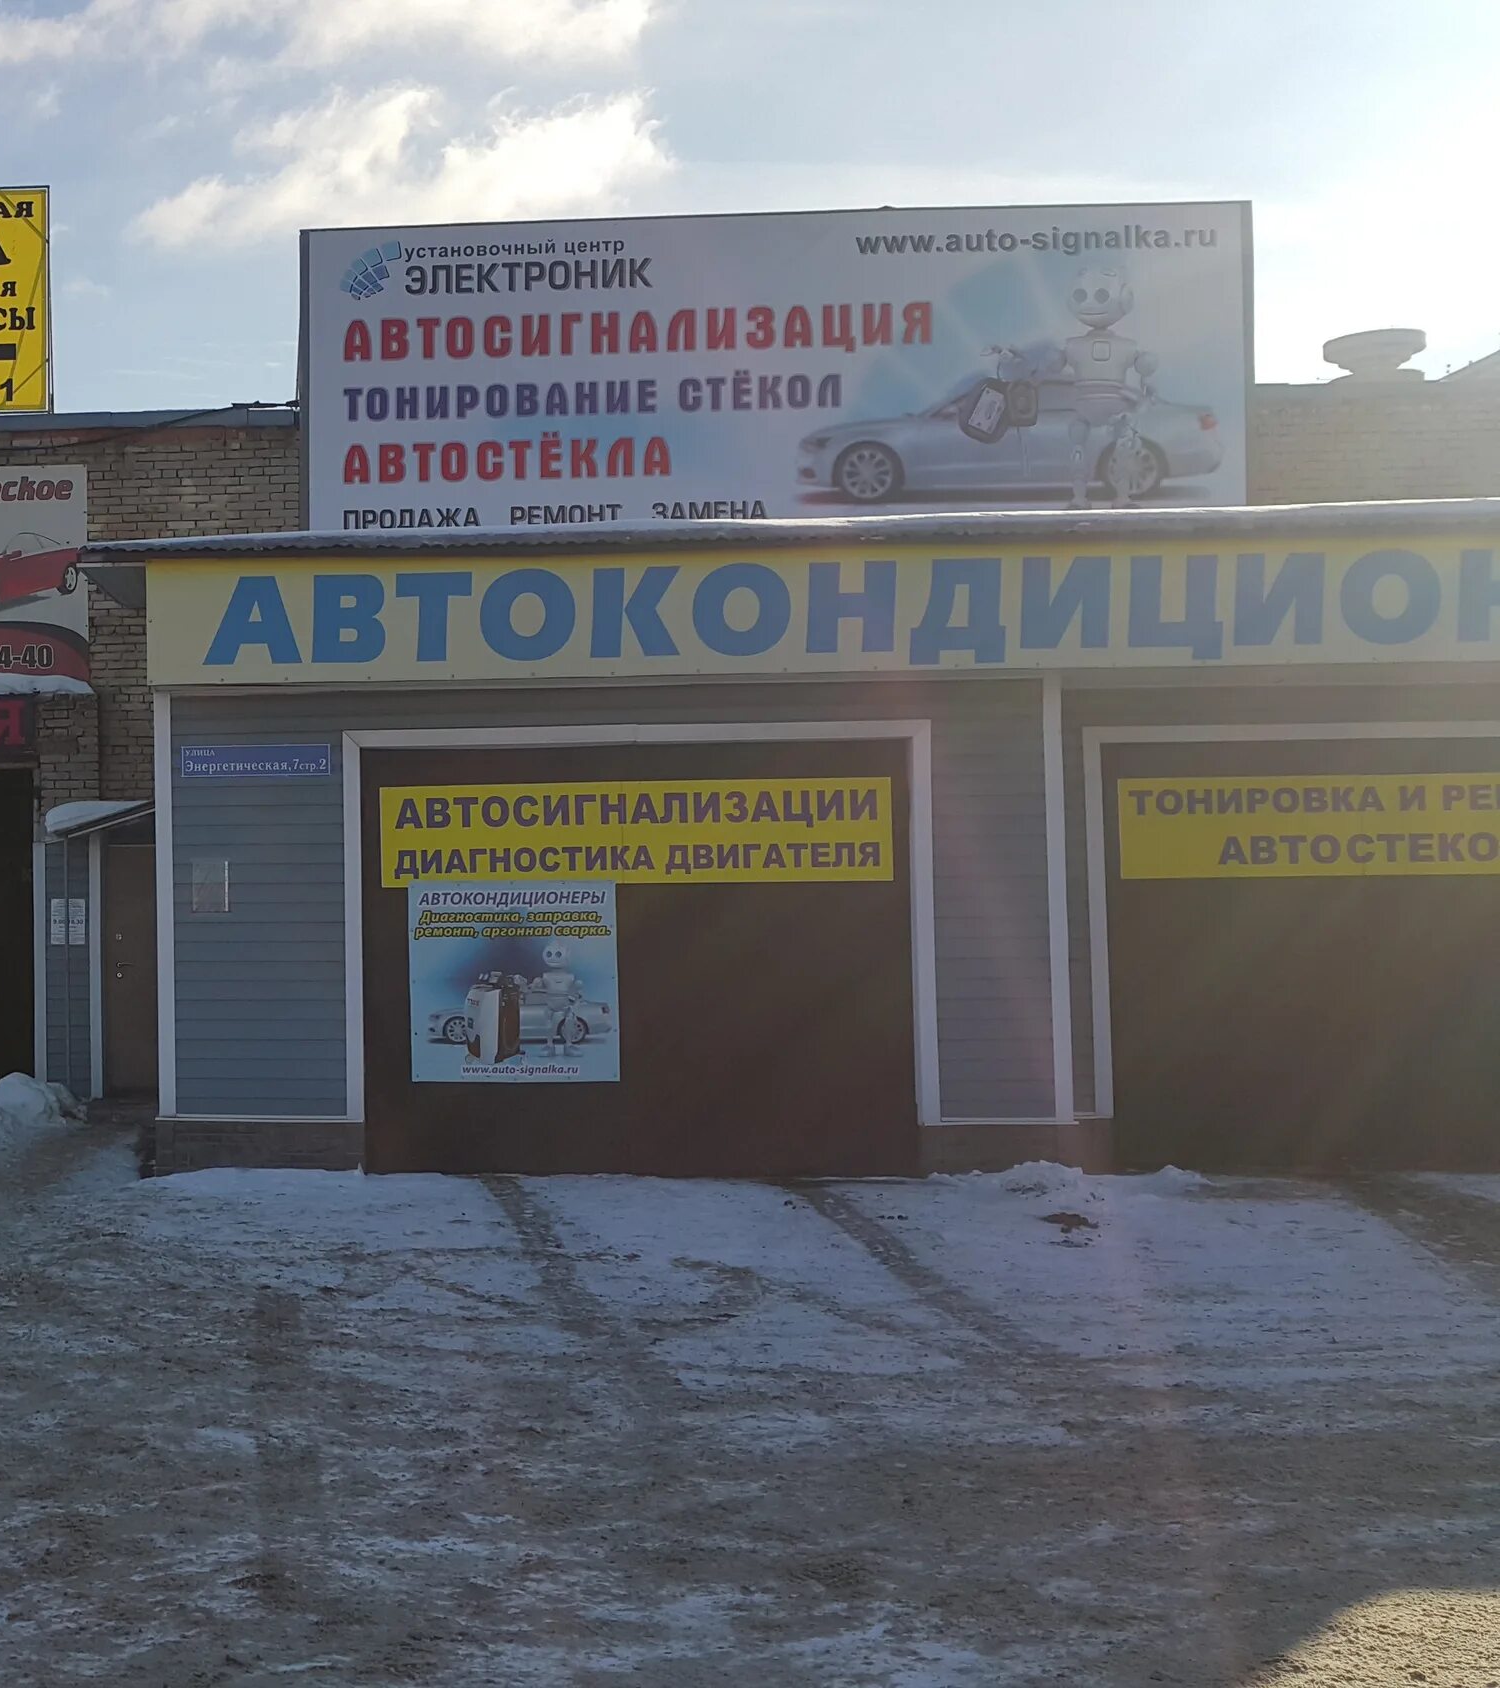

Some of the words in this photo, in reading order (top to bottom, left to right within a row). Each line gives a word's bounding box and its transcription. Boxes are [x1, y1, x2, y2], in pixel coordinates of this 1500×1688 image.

[404, 240, 556, 262] установочный
[564, 238, 625, 256] центр
[856, 224, 1218, 255] www.auto-signalka.ru
[404, 257, 653, 296] ЭЛЕКТРОНИК
[343, 302, 933, 361] АВТОСИГНАЛИЗАЦИЯ
[343, 378, 658, 422] ТОНИРОВАНИЕ
[679, 370, 842, 413] СТЁКОЛ
[343, 431, 671, 484] АВТОСТЁКЛА
[343, 507, 481, 529] ПРОДАЖА
[510, 503, 623, 525] РЕМОНТ
[652, 500, 767, 519] ЗАМЕНА
[395, 788, 879, 830] АВТОСИГНАЛИЗАЦИИ
[1128, 787, 1385, 816] ТОНИРОВКА
[1399, 785, 1426, 812] И
[1442, 784, 1500, 811] РЕ
[395, 844, 655, 880] ДИАГНОСТИКА
[665, 841, 881, 875] ДВИГАТЕЛЯ
[1218, 832, 1500, 865] АВТОСТЕКО
[419, 891, 606, 908] АВТОКОНДИЦИОНЕРЫ
[414, 926, 479, 939] ремонт,
[483, 926, 551, 939] аргонная
[555, 925, 611, 939] сварка.
[419, 911, 524, 925] Диагностика,
[527, 910, 602, 924] заправка,
[462, 1065, 579, 1075] www.auto-signalka.ru
